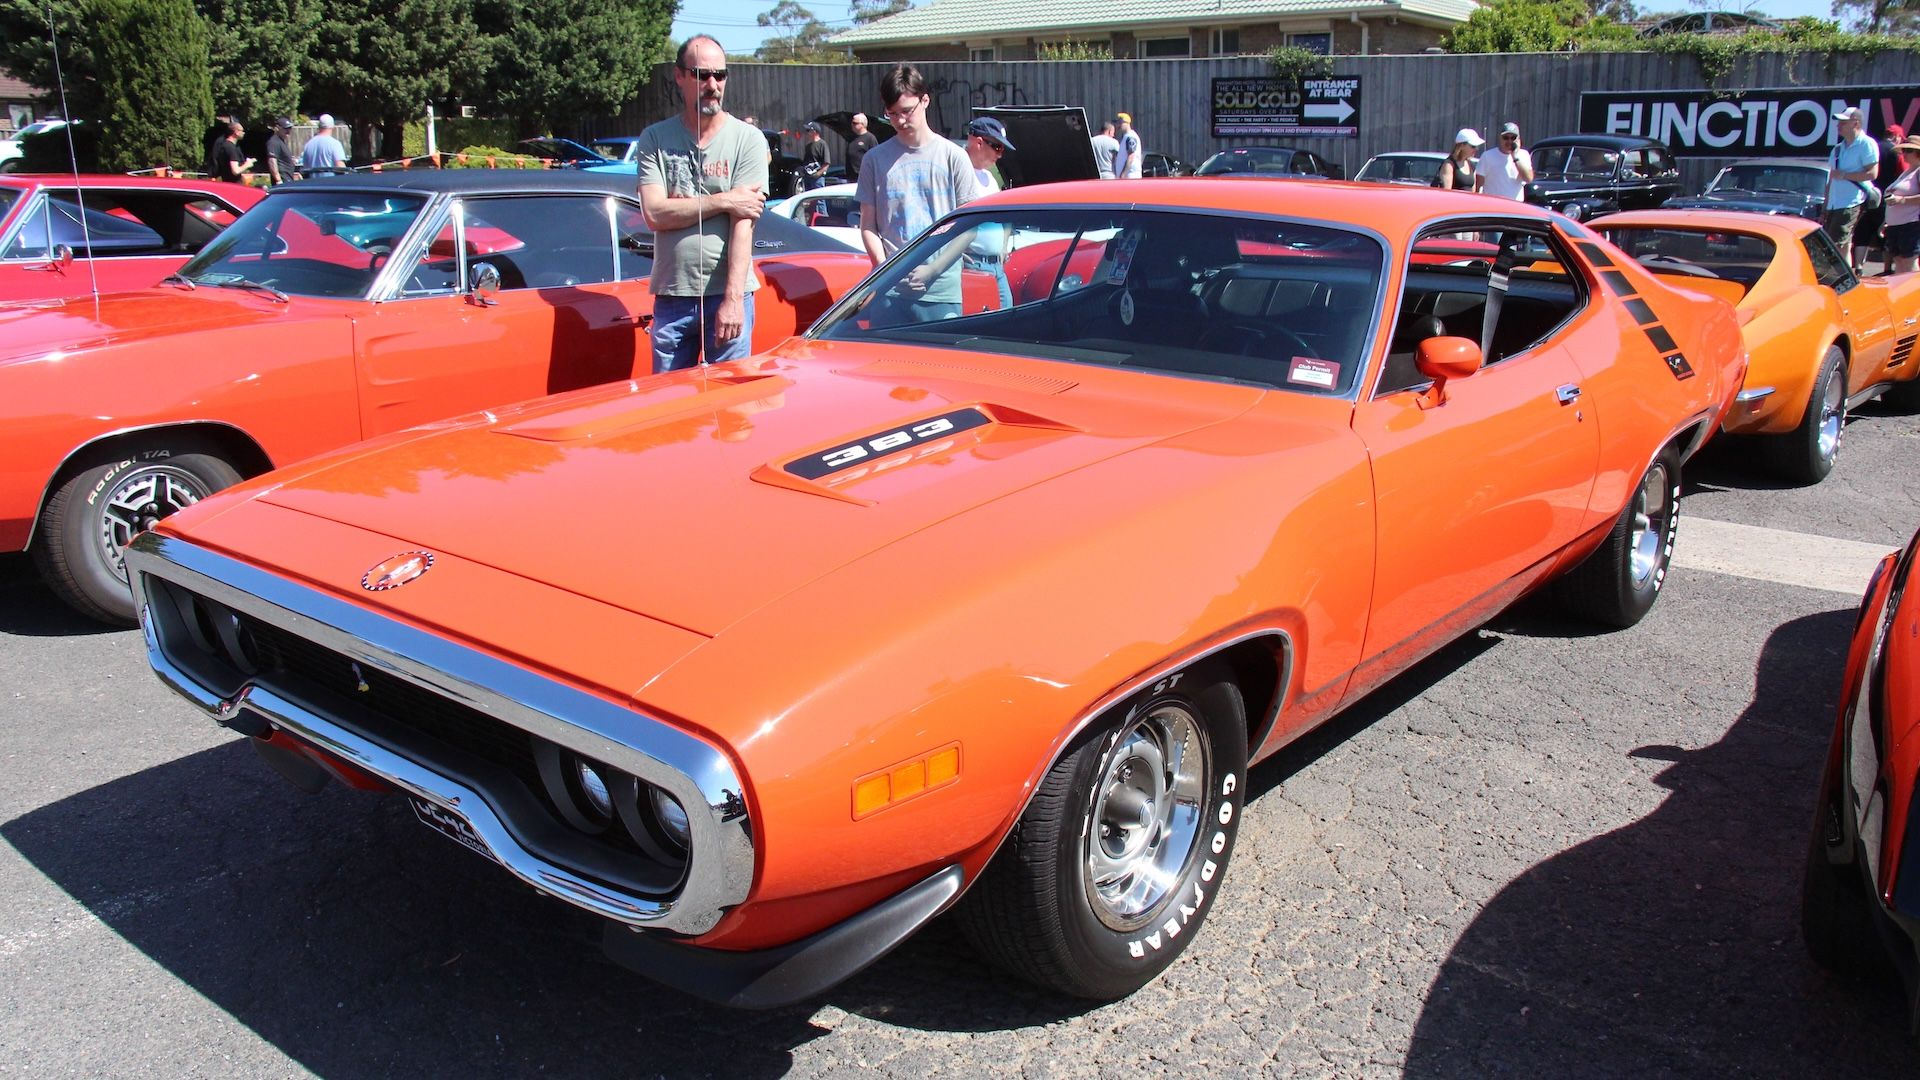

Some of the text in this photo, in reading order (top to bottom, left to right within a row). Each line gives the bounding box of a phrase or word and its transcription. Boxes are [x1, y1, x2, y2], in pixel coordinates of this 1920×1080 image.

[1304, 80, 1358, 89] ENTRANCE
[1309, 89, 1352, 97] AT REAR
[1215, 92, 1301, 108] SOLID GOLD
[822, 418, 954, 467] 383
[87, 449, 170, 505] Radial T/A
[1152, 673, 1184, 696] ST
[1128, 772, 1237, 959] GOODYEAR
